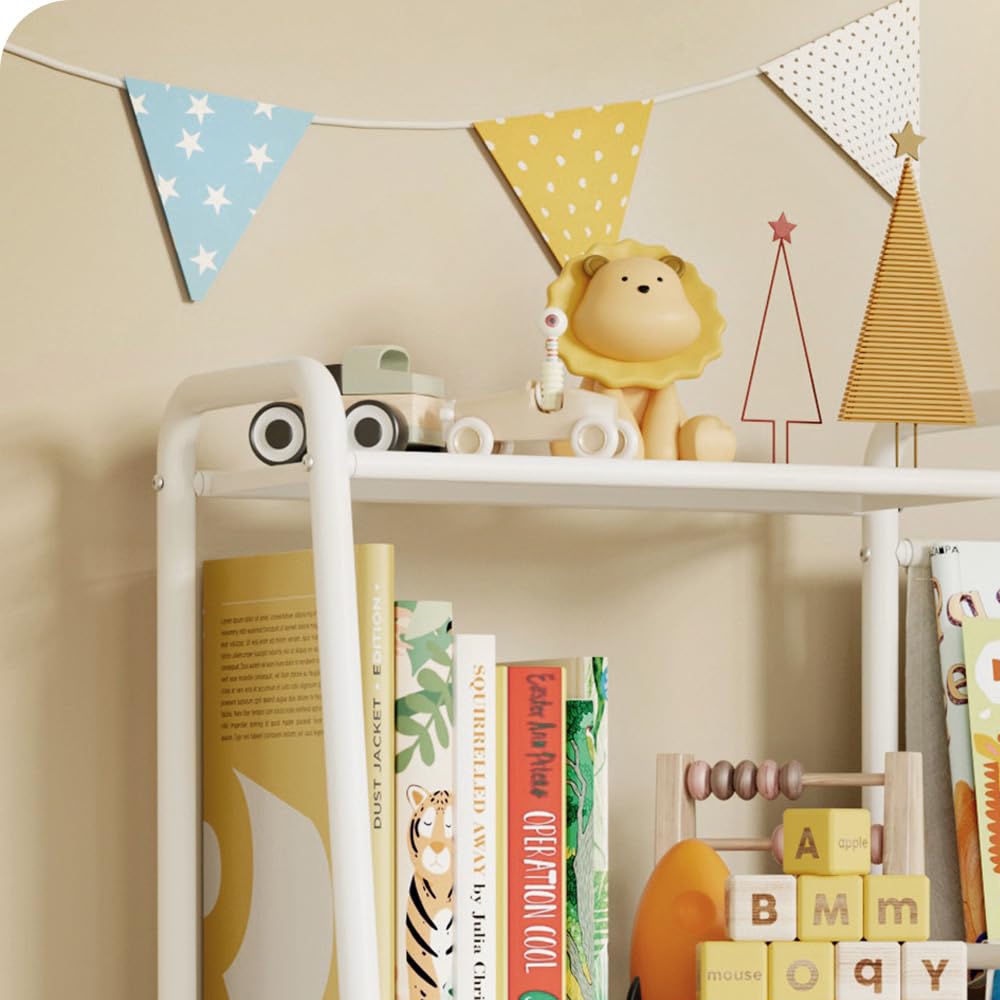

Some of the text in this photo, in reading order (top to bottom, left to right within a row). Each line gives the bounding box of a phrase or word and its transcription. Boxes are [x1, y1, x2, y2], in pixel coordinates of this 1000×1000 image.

[372, 597, 382, 830] DUST JACKET EDITION
[470, 664, 486, 814] SQUIRRELLED
[472, 822, 486, 876] AWAY
[795, 827, 820, 860] A
[838, 837, 869, 851] apple
[470, 883, 486, 905] by
[523, 810, 558, 974] OPERATION COOL
[751, 893, 778, 926] B
[812, 893, 849, 926] M
[877, 897, 918, 925] m
[471, 911, 486, 954] Julia
[706, 968, 763, 982] mouse
[786, 959, 819, 991] O
[853, 958, 882, 994] q
[921, 958, 950, 992] Y
